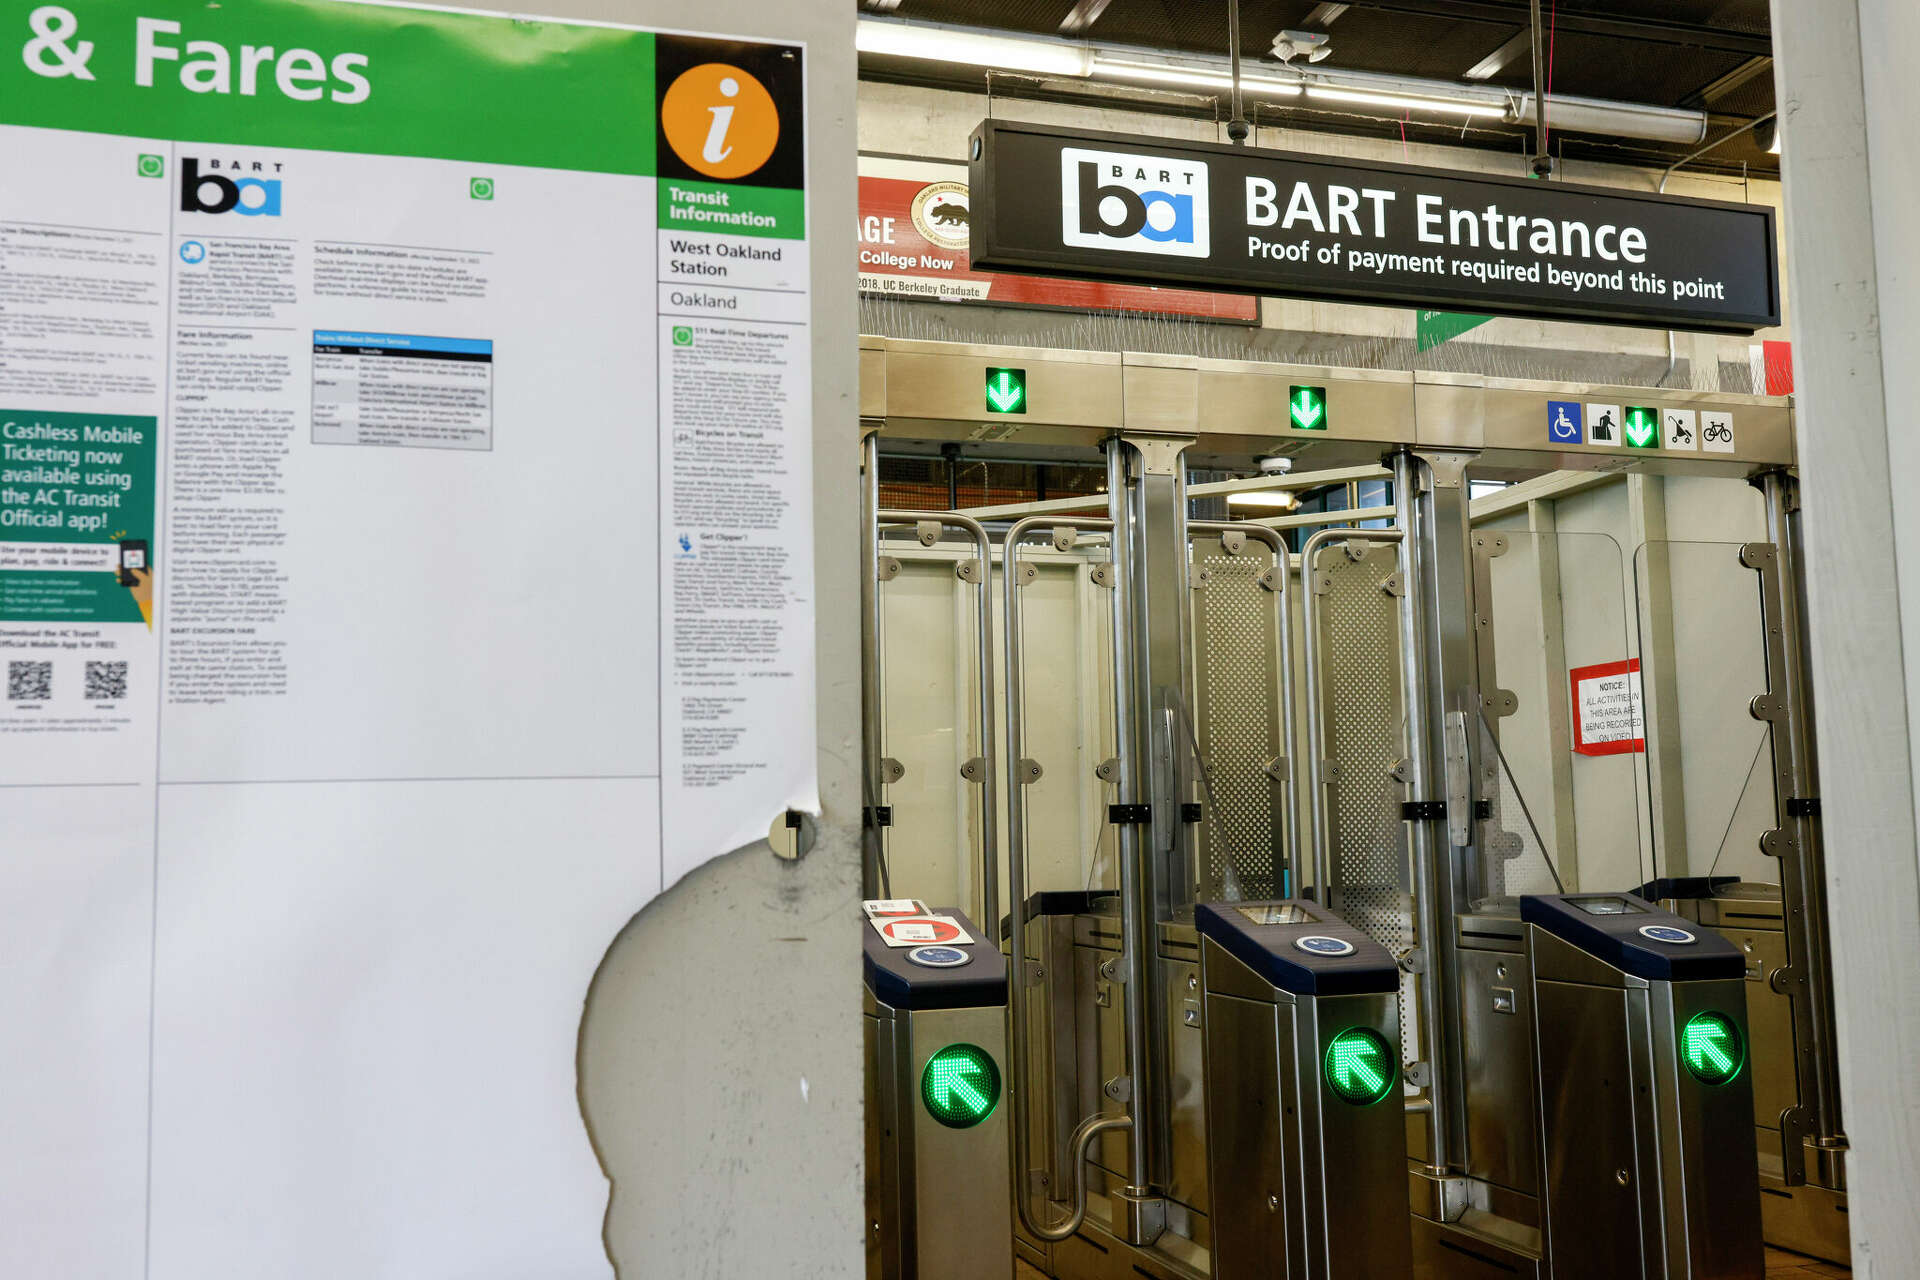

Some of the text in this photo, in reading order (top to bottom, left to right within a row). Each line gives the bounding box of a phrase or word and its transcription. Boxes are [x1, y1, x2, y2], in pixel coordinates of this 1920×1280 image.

[22, 5, 371, 104] & Fares
[211, 159, 283, 173] BART
[1112, 165, 1194, 185] BART
[669, 186, 729, 206] Transit
[939, 184, 964, 192] MILITARY
[669, 205, 776, 228] Information
[1245, 175, 1648, 264] BART Entrance
[314, 245, 354, 255] Schedule
[670, 239, 782, 261] West Oakland
[860, 250, 954, 270] College Now
[671, 259, 728, 277] Station
[1248, 236, 1725, 301] Proof of payment required beyond this point
[883, 279, 896, 291] UC
[898, 282, 938, 296] Berkeley
[940, 283, 980, 297] Graduate
[670, 291, 738, 310] Oakland
[2, 421, 144, 445] Cashless Mobile
[2, 443, 124, 467] Ticketing now
[1, 466, 132, 491] available using
[1, 486, 121, 508] the AC Transit
[0, 508, 108, 533] Official app!
[1599, 681, 1625, 692] NOTICE:
[1597, 693, 1631, 705] ACTIVITIES
[1631, 692, 1640, 700] IN
[1590, 705, 1636, 718] THIS AREA ARE
[1585, 718, 1641, 731] BEING RECORDED
[1599, 734, 1609, 742] ON
